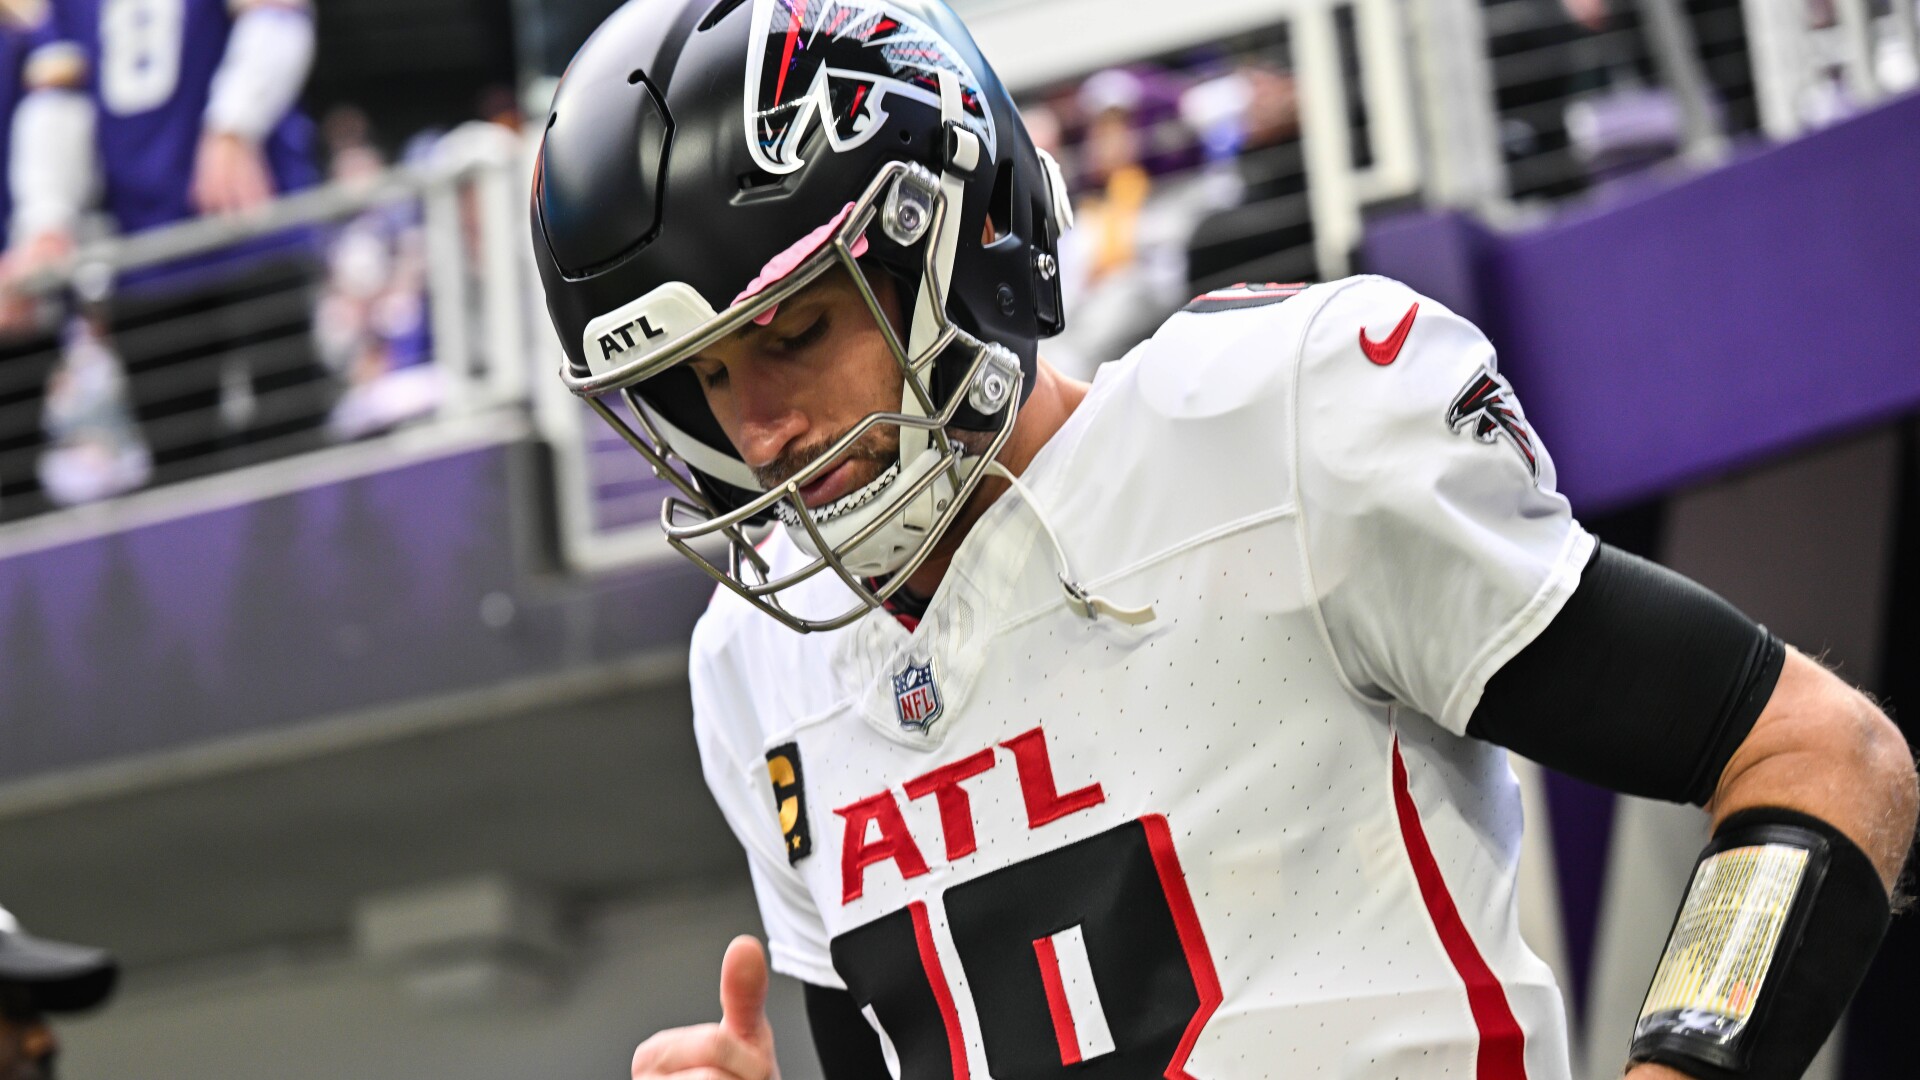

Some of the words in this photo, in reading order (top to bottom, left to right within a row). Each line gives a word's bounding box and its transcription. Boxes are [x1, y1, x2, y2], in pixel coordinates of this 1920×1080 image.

[597, 315, 664, 360] ATL
[900, 687, 934, 721] NFL
[833, 726, 1105, 906] ATL
